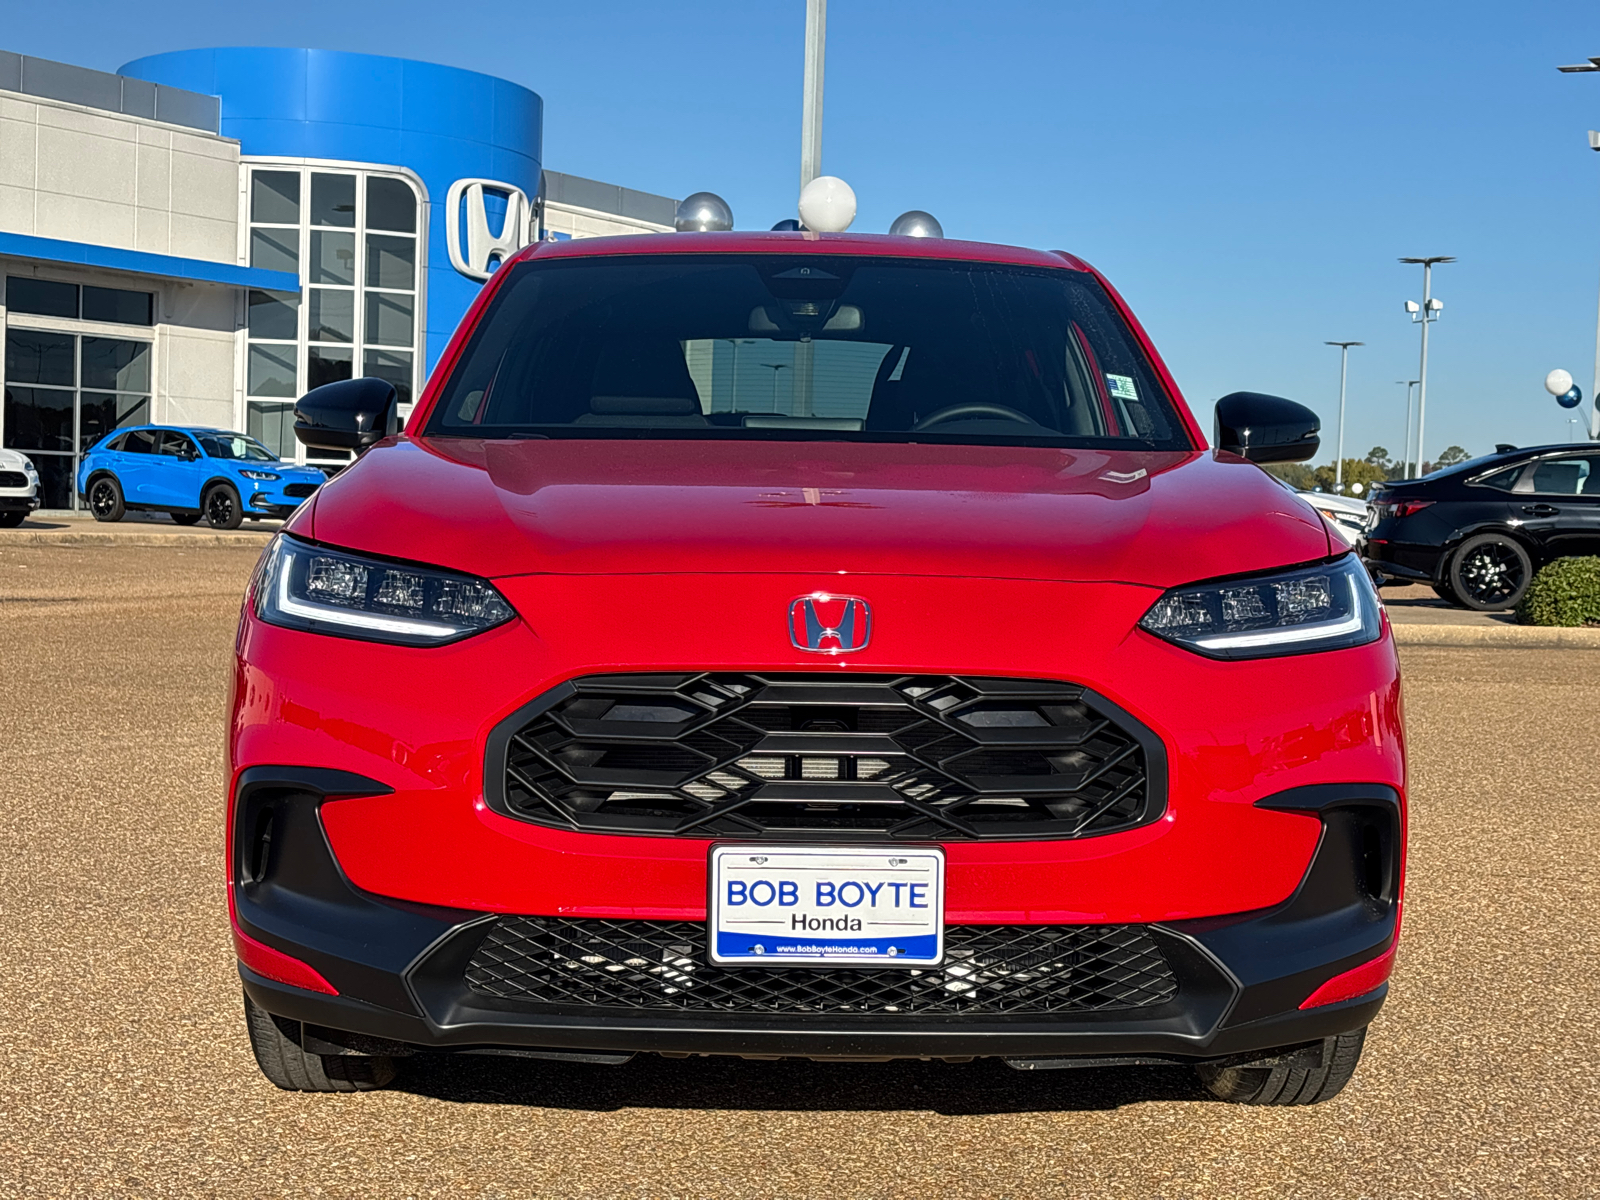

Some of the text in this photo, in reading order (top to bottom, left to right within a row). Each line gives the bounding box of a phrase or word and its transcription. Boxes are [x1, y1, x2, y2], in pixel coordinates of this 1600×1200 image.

[727, 880, 929, 908] BOB BOYTE
[791, 913, 862, 931] Honda
[776, 944, 878, 955] www.BobBoyteHonda.com
